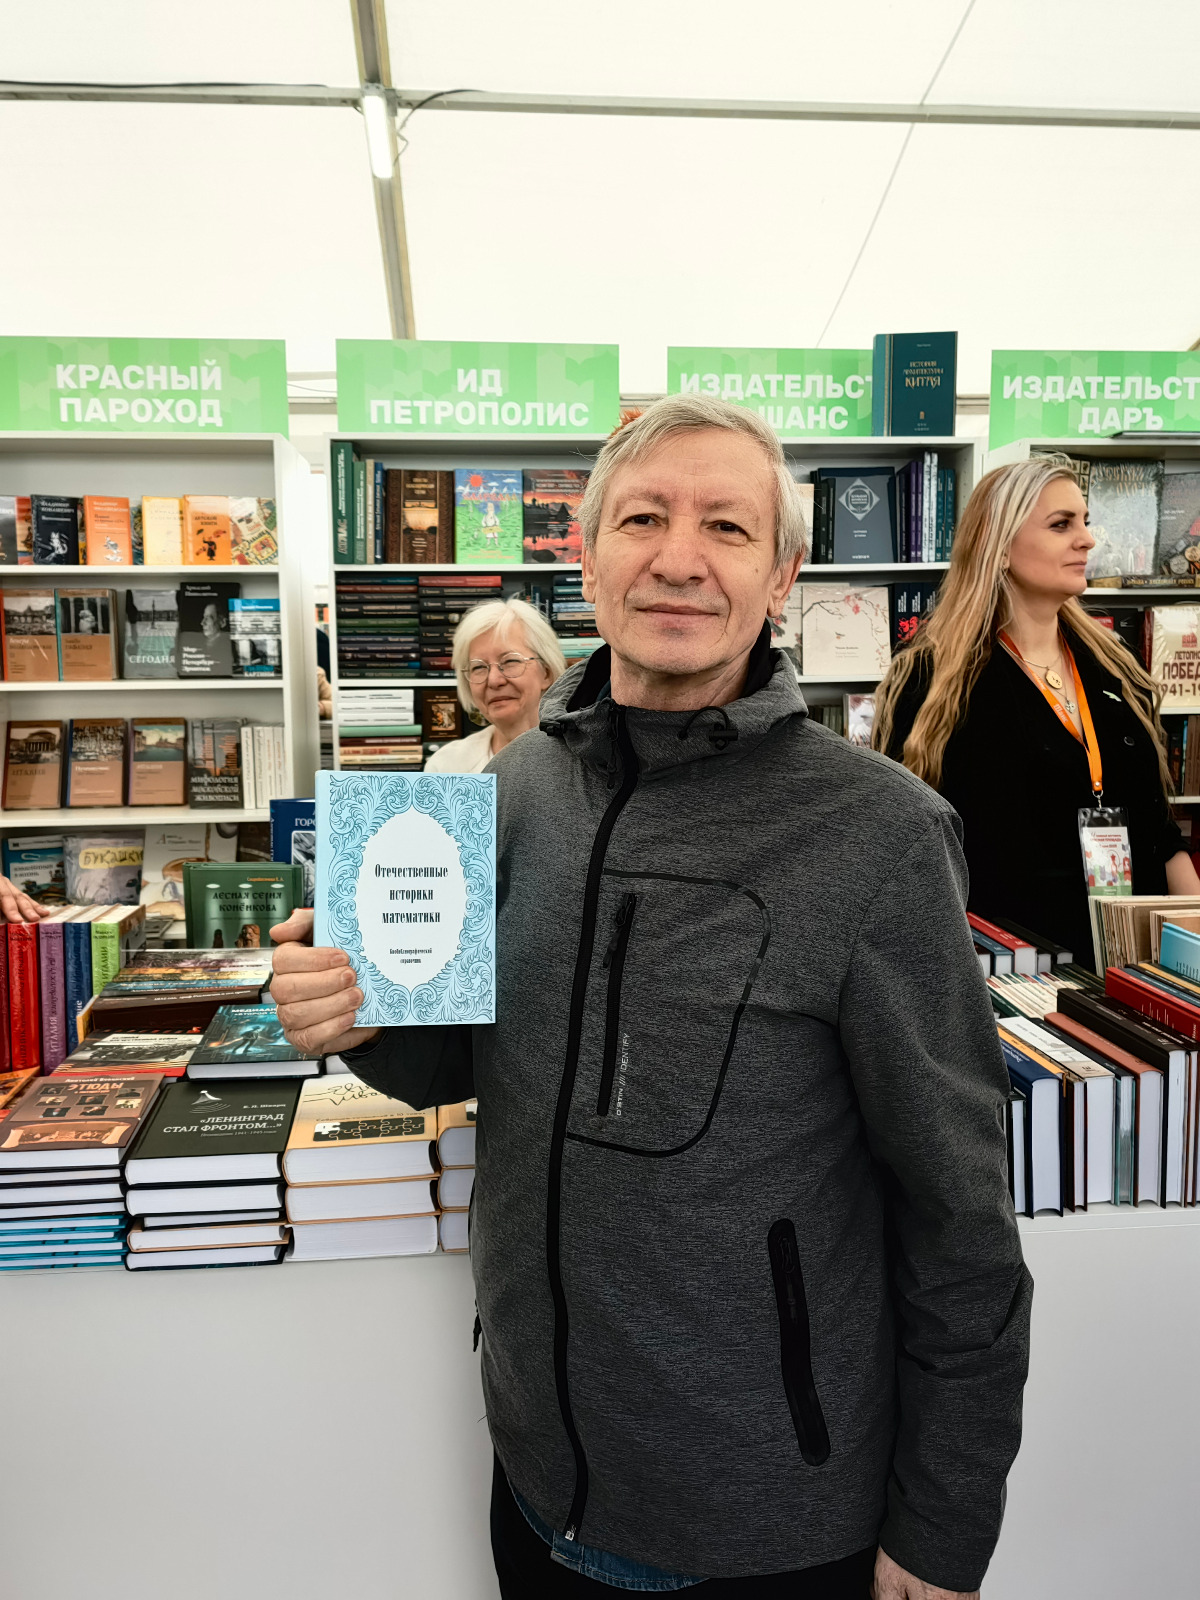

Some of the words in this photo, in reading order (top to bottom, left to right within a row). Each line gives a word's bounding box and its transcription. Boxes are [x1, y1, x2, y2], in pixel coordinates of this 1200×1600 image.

[56, 359, 222, 390] КРАСНЫЙ
[457, 368, 503, 397] ИД
[905, 376, 940, 389] КИТАЯ
[59, 397, 223, 427] ПАРОХОД
[370, 399, 589, 427] ПЕТРОПОЛИС
[1078, 407, 1164, 433] ДАРЪ
[129, 655, 175, 664] СЕГОДНЯ
[375, 864, 448, 878] Отечественные
[389, 889, 434, 904] историки
[382, 912, 441, 923] математики
[620, 1033, 630, 1072] IDENTIFY
[67, 1082, 124, 1091] ЭТЮДЫ
[200, 1114, 284, 1123] «ЛЕНИНГРАД
[163, 1125, 199, 1133] СТАЛ
